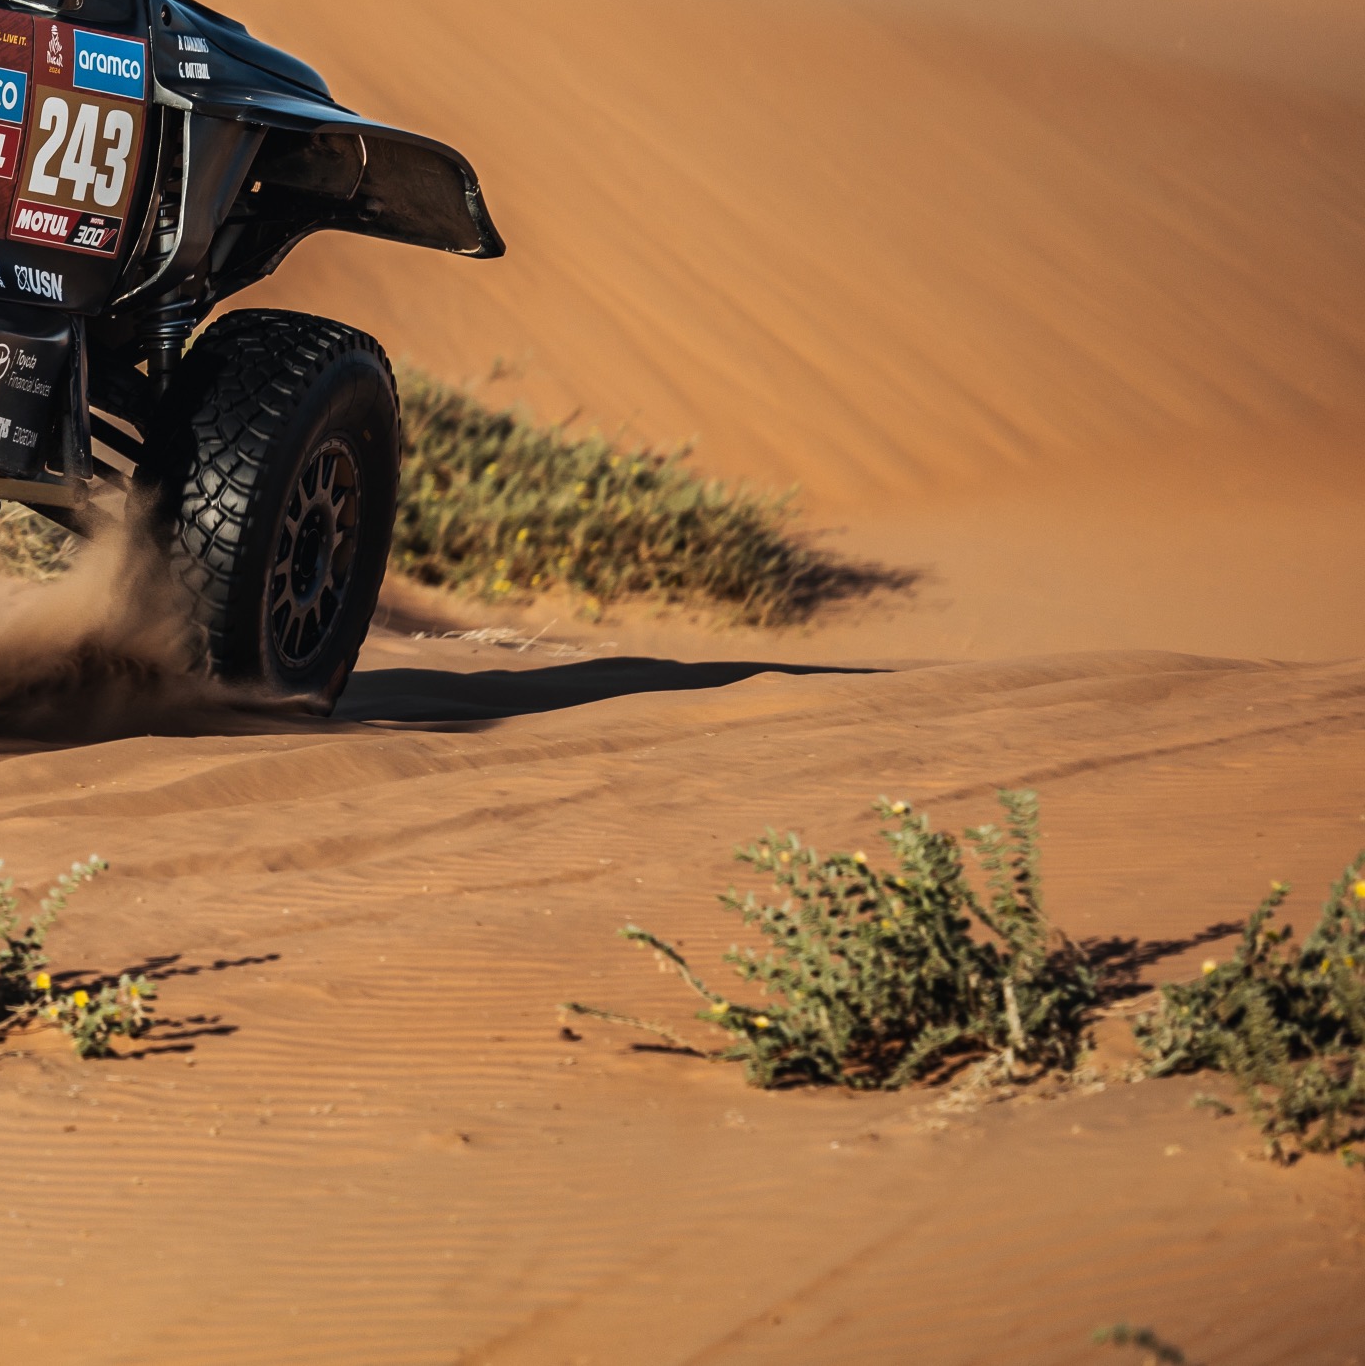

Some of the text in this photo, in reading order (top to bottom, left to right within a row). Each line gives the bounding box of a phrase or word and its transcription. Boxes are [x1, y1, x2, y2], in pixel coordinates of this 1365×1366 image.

[3, 33, 18, 44] LIVE
[18, 36, 27, 46] IT.
[49, 66, 61, 74] 2024
[78, 50, 141, 80] aramco
[28, 96, 134, 208] 243
[15, 208, 69, 237] MOTUL
[73, 225, 118, 248] 300V
[28, 267, 63, 302] USN
